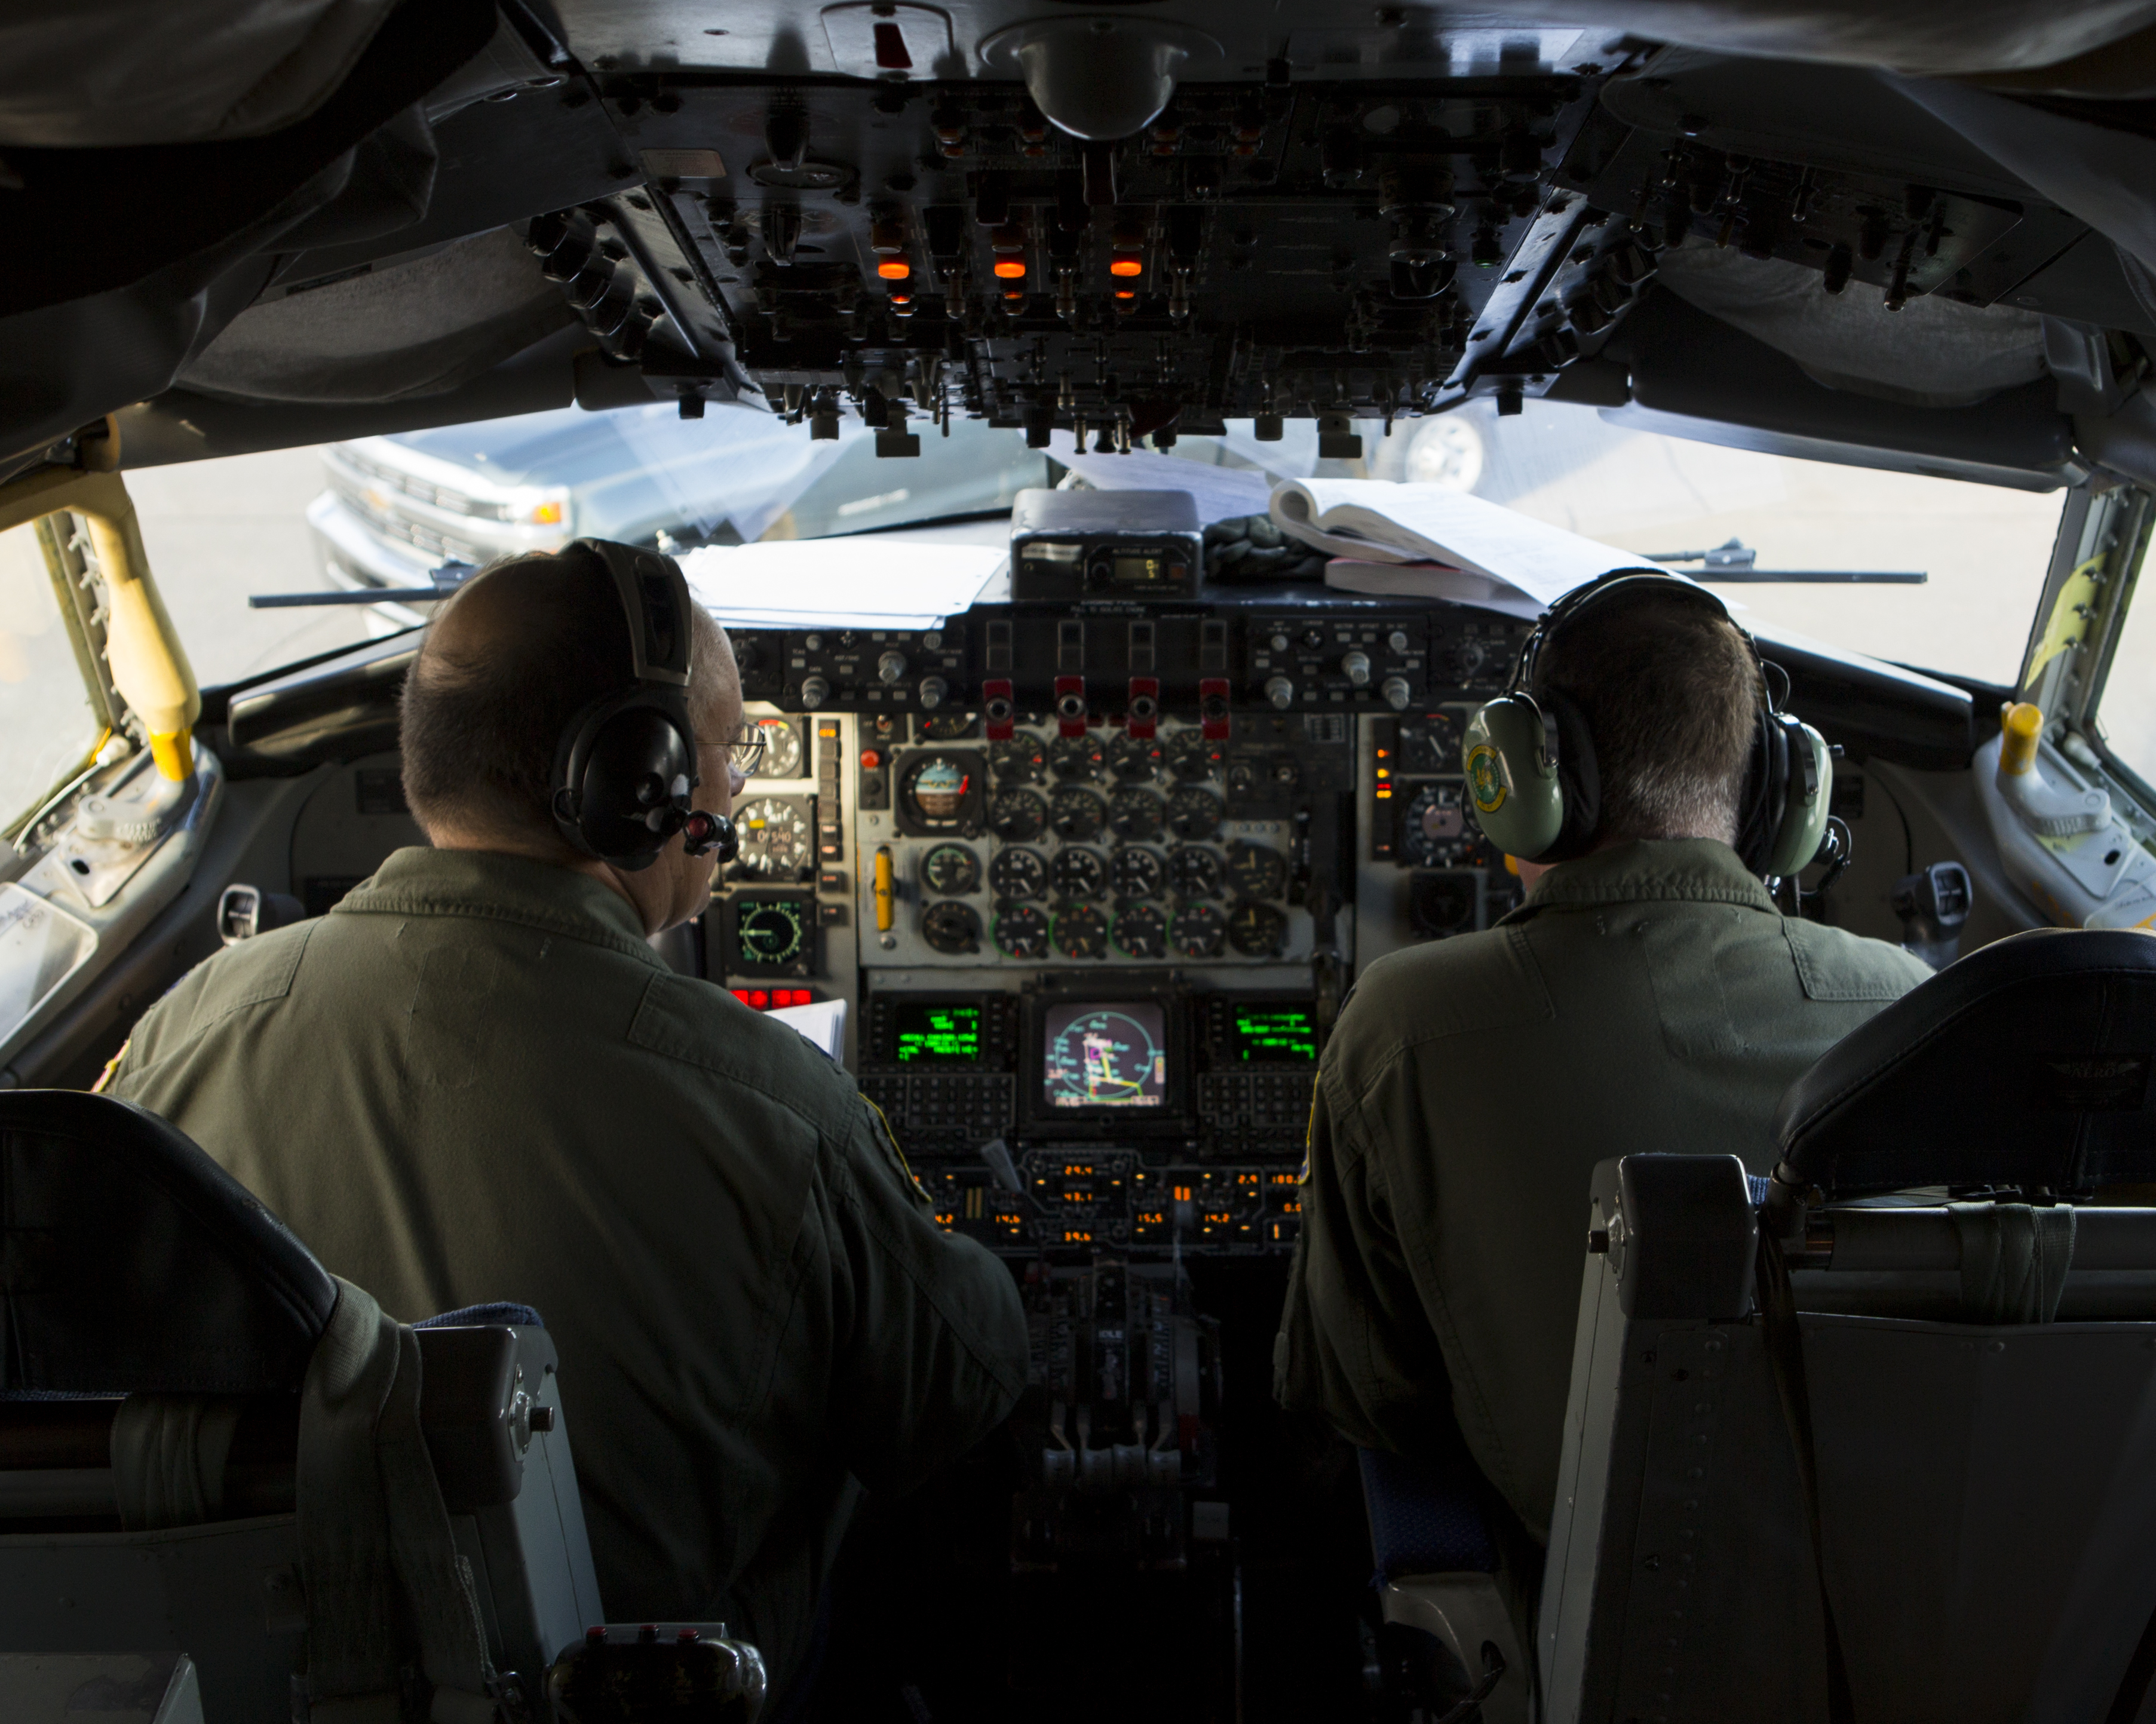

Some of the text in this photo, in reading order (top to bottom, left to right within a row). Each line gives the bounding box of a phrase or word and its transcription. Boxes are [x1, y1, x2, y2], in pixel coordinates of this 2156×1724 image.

[1065, 1165, 1092, 1176] 29.4
[1238, 1174, 1258, 1184] 2.9
[1272, 1174, 1301, 1184] 180.
[1065, 1192, 1091, 1201] 43.1
[996, 1215, 1020, 1223] 14.6
[1139, 1213, 1163, 1223] 15.5
[1205, 1213, 1229, 1223] 14.2
[1065, 1232, 1091, 1241] 39.6
[1099, 1330, 1123, 1339] IDLE
